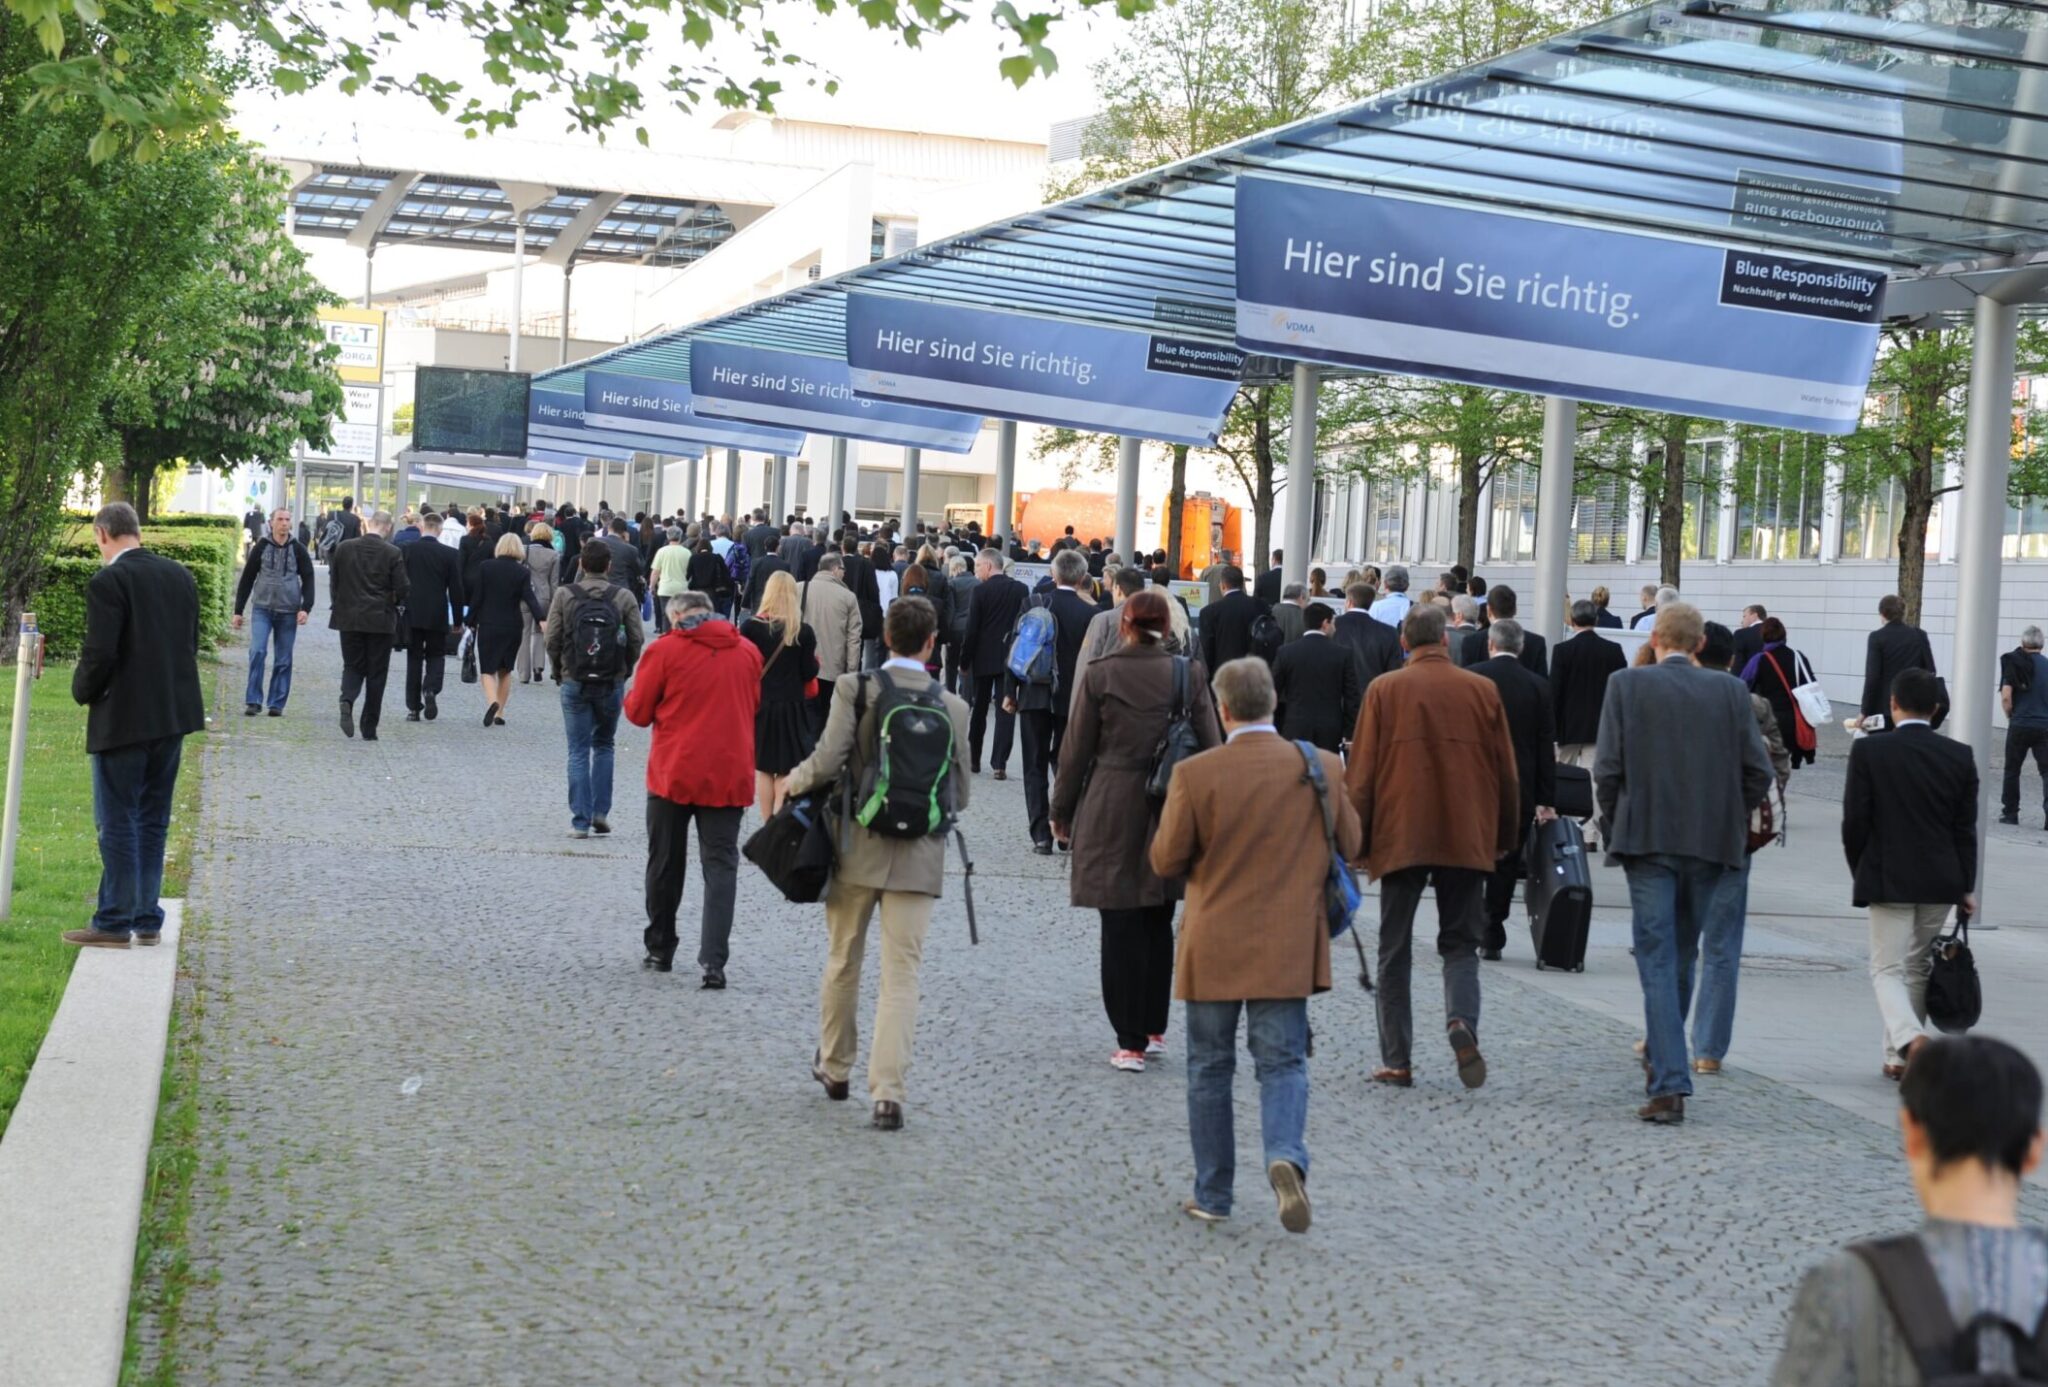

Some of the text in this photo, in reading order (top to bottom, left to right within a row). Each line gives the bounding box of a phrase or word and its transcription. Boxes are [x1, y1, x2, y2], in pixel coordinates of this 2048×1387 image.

[1284, 237, 1640, 328] Hier sind Sie richtig.
[1735, 259, 1876, 297] Blue Responsibility
[1732, 284, 1873, 312] Nachhaltige Wassertechnologie
[1286, 322, 1315, 334] VDMA
[877, 328, 1097, 385] Hier sind Sie richtig.
[1156, 343, 1244, 366] Blue Responsibility
[712, 366, 749, 385] Hier
[751, 373, 786, 391] sind
[790, 377, 815, 395] Sie
[538, 404, 561, 417] Hier
[602, 390, 630, 405] Hier
[632, 395, 659, 410] sind
[662, 399, 684, 413] Sie
